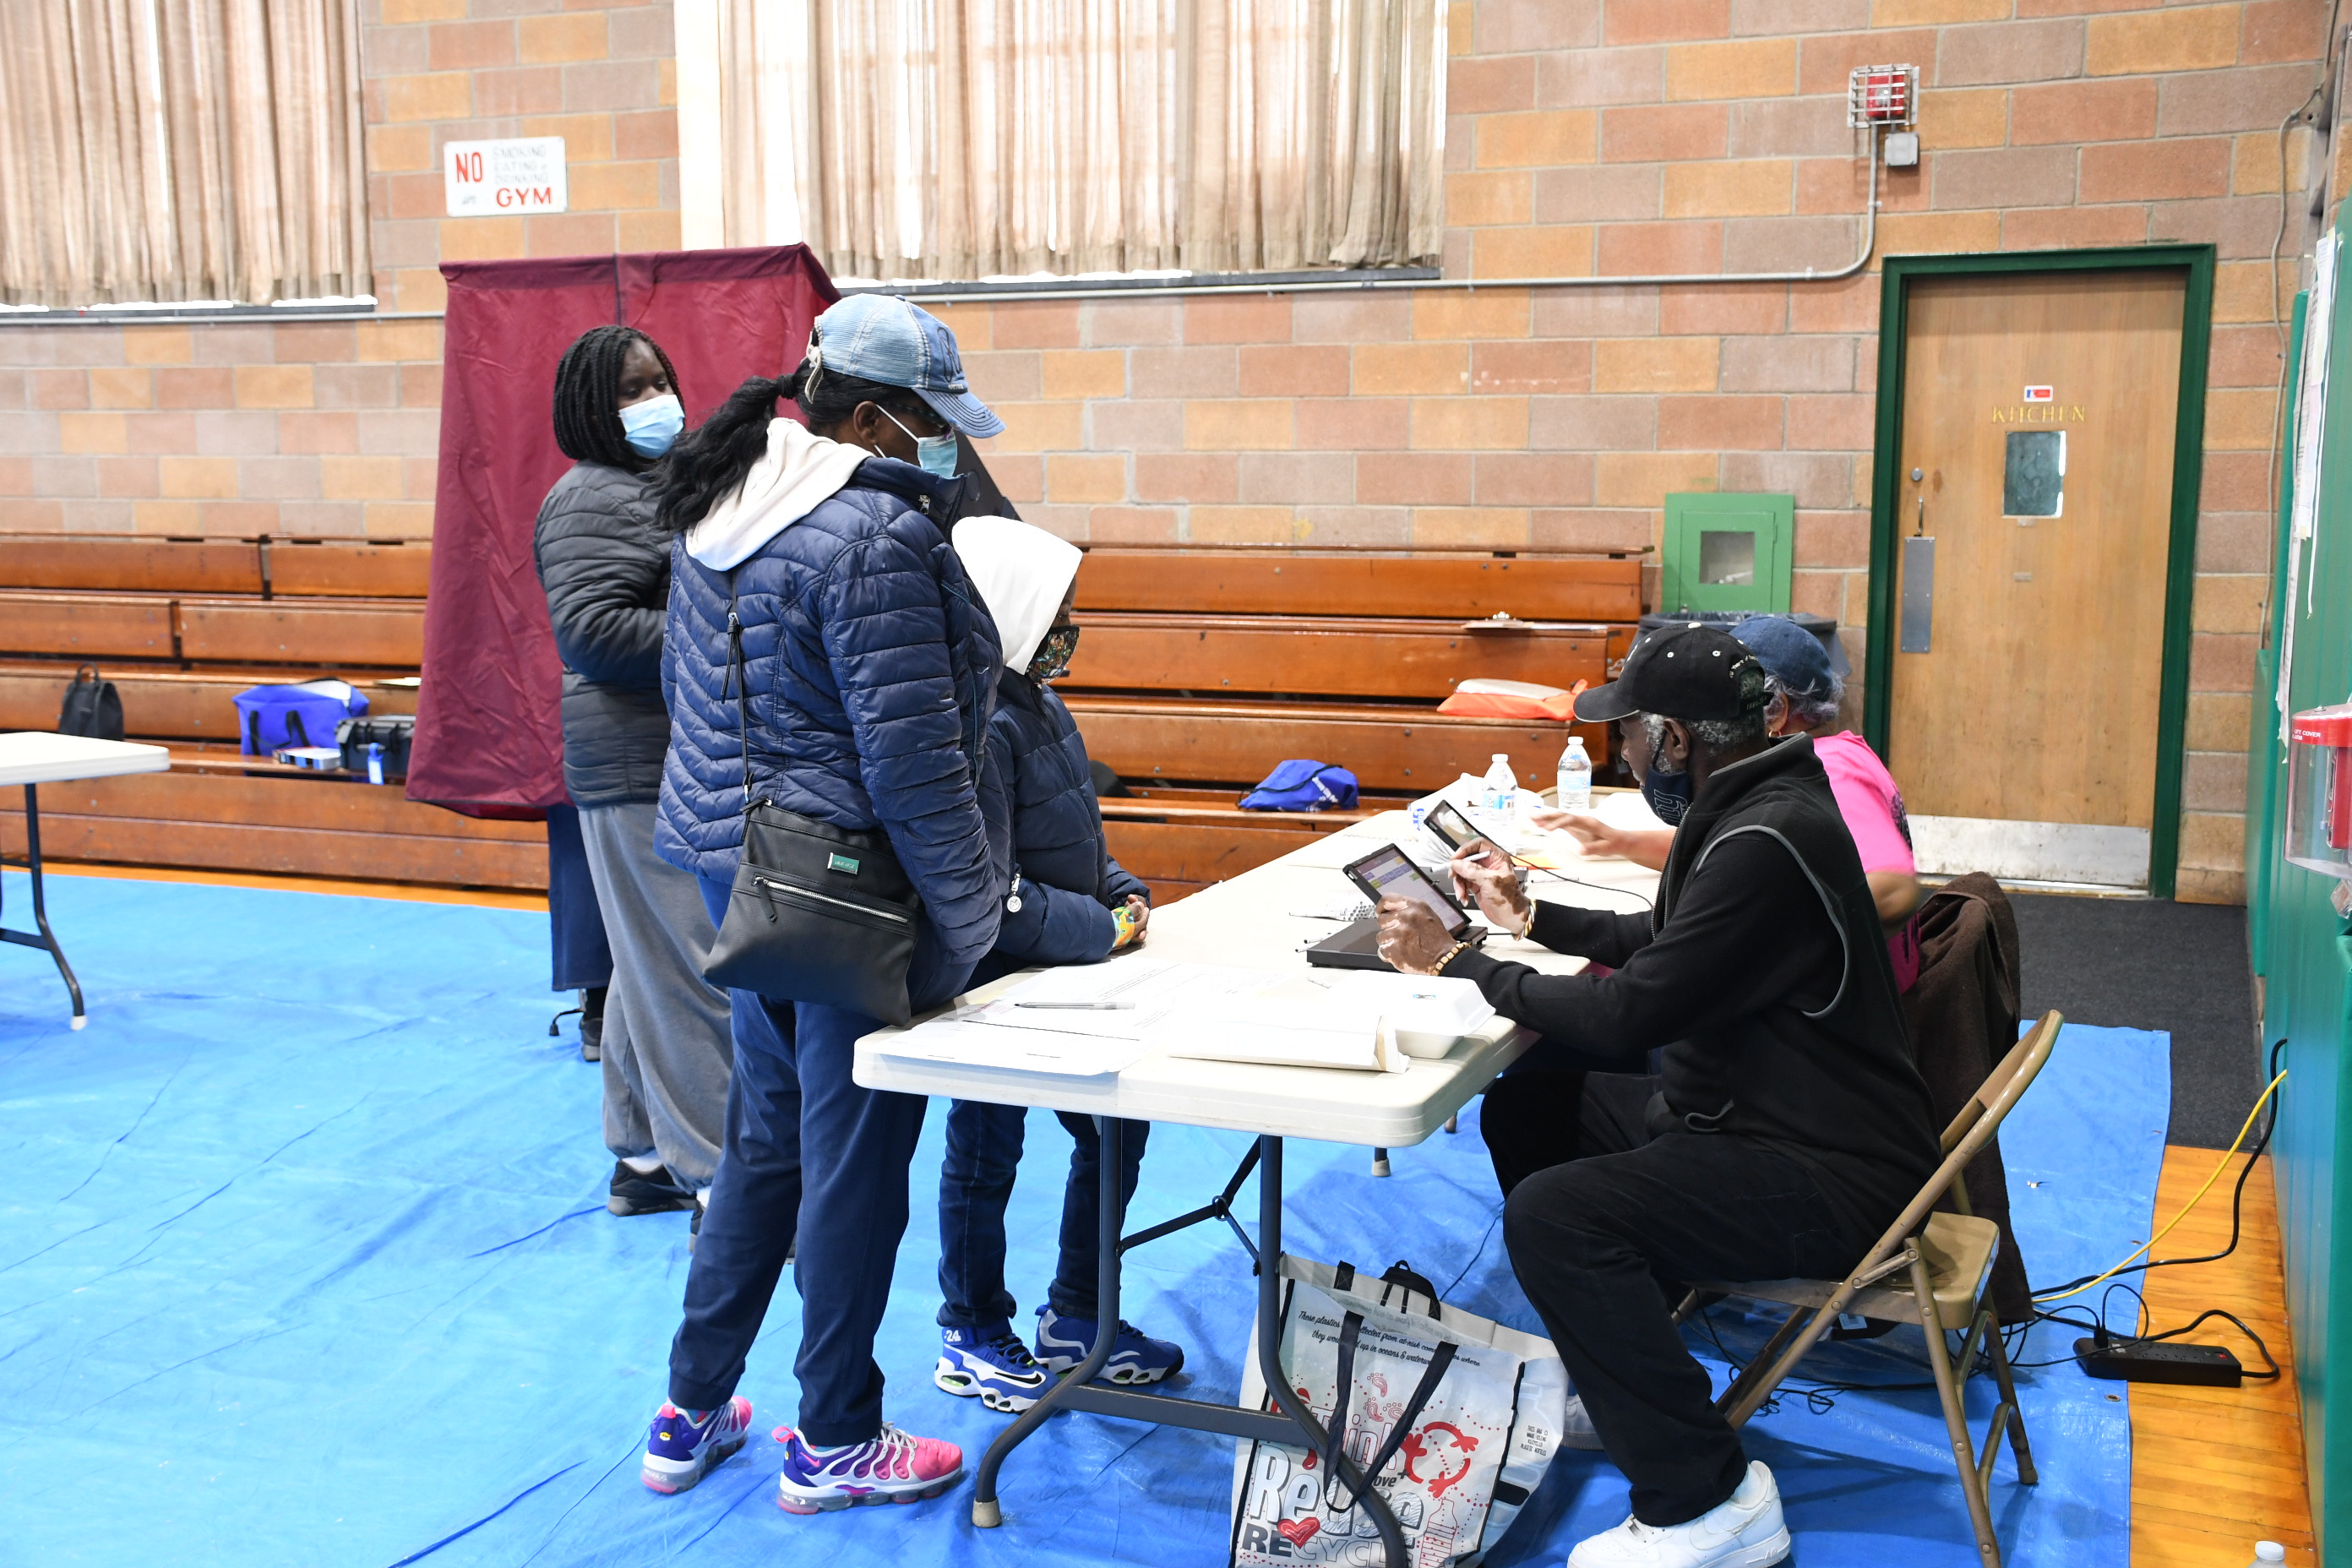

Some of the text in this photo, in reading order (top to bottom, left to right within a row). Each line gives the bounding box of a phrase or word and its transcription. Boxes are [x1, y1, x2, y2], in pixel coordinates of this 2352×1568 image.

[455, 150, 484, 183] NO
[495, 186, 553, 208] GYM
[1991, 405, 2086, 423] KITCHEN
[946, 1329, 962, 1342] 24
[1298, 1310, 1315, 1322] These
[1315, 1315, 1341, 1328] plastics
[1359, 1326, 1381, 1337] llected
[1380, 1332, 1397, 1342] from
[1398, 1337, 1420, 1348] at-risk
[1461, 1356, 1480, 1367] where
[1311, 1330, 1326, 1343] they
[1326, 1335, 1340, 1344] wou
[1359, 1343, 1369, 1353] up
[1370, 1344, 1377, 1353] in
[1378, 1348, 1399, 1358] oceans
[1399, 1350, 1407, 1359] &
[1406, 1352, 1431, 1365] waterw
